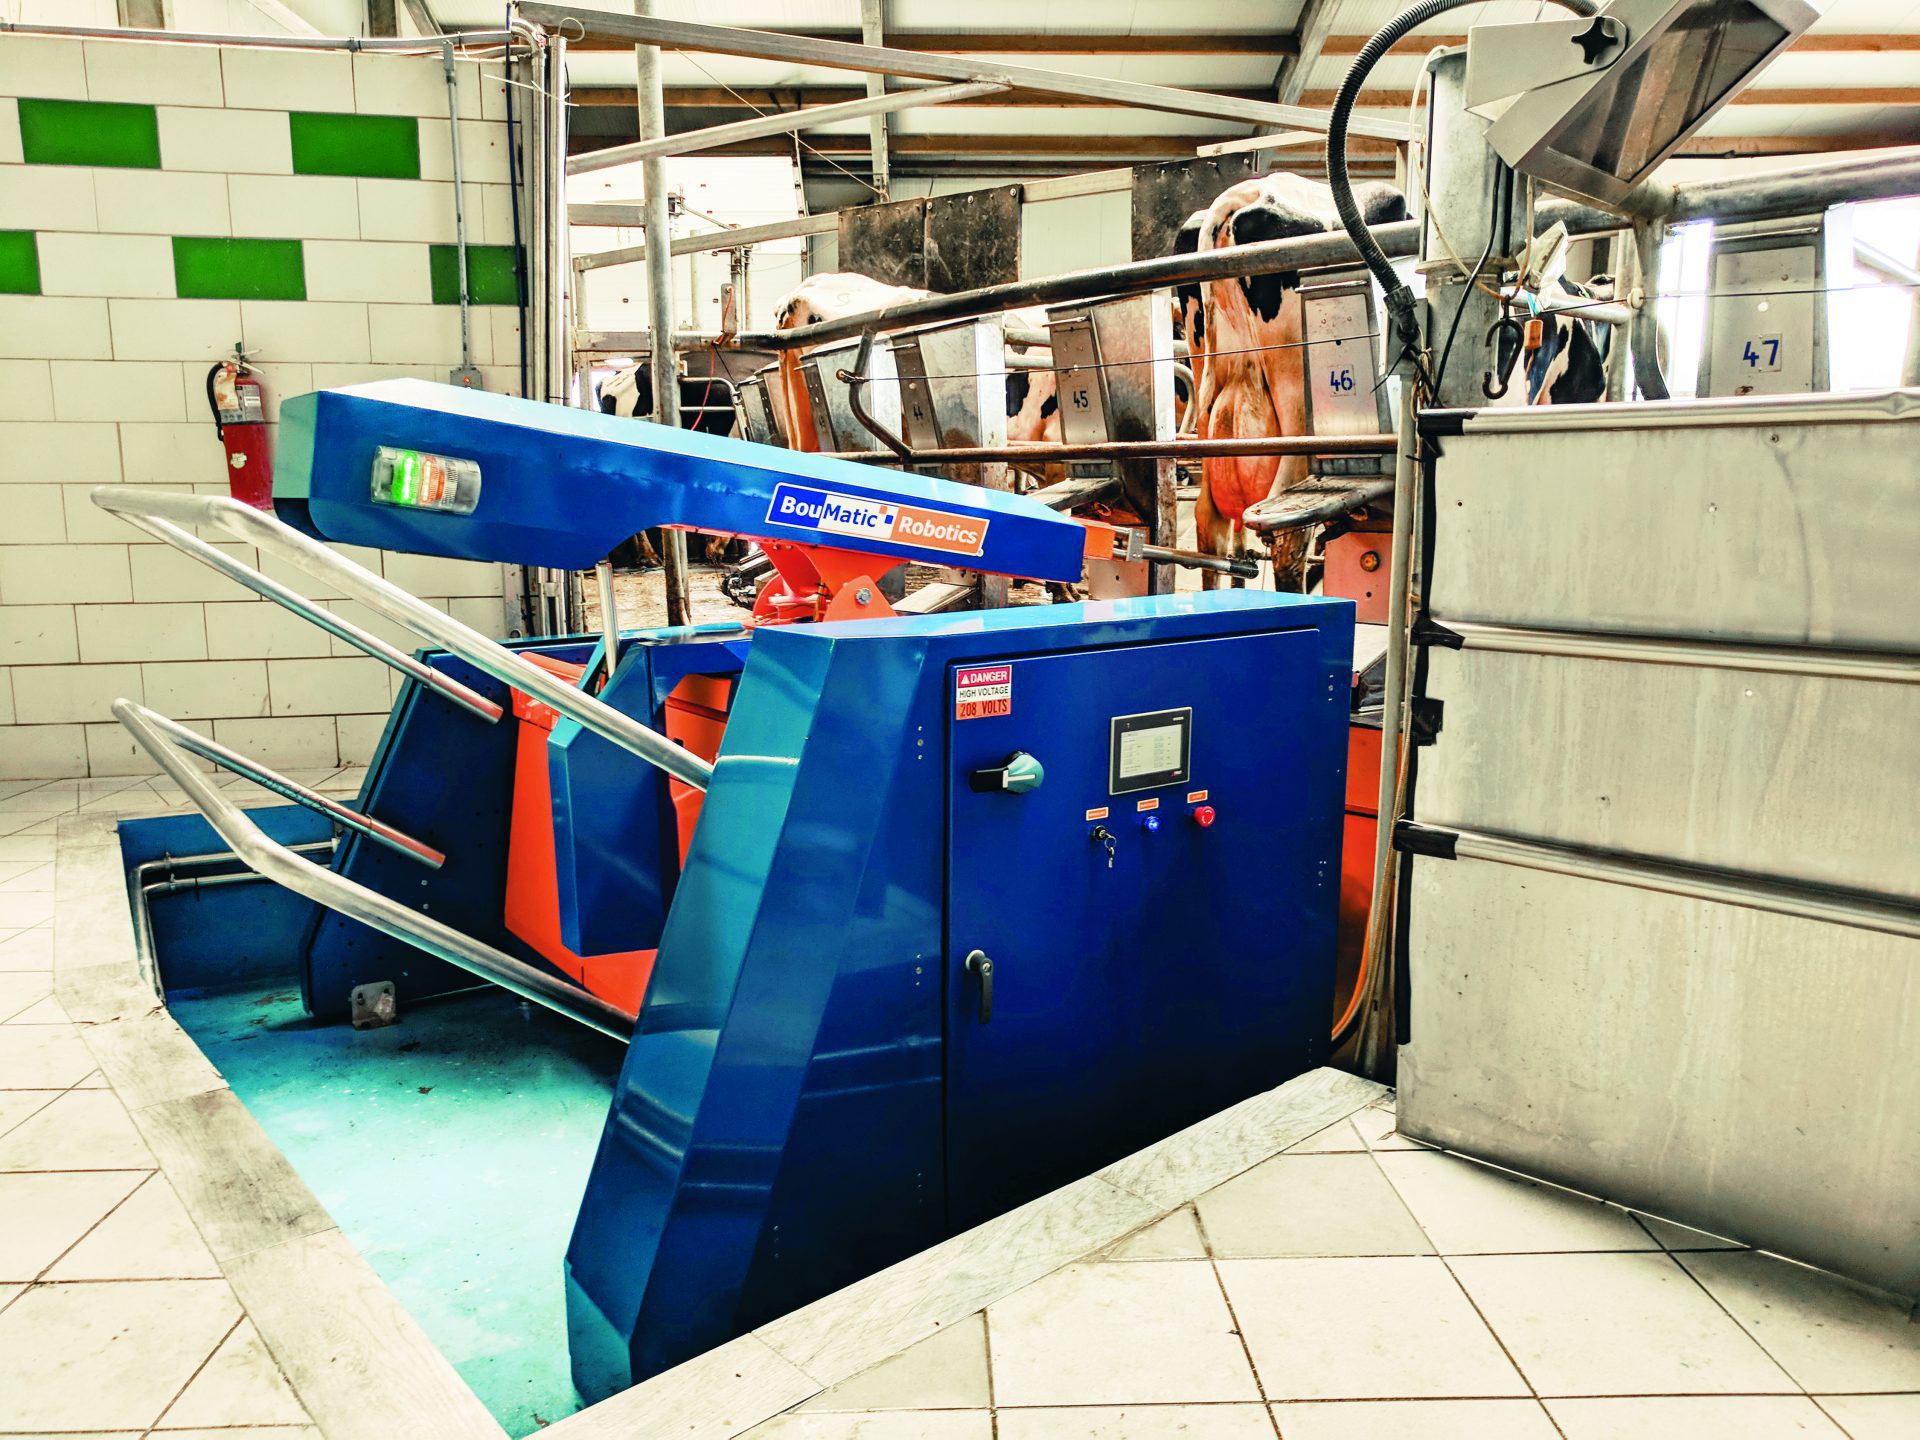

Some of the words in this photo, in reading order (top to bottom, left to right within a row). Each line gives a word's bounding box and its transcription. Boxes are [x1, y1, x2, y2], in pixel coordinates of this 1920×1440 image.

[1742, 339, 1779, 367] 47
[1330, 369, 1353, 391] 46
[1073, 390, 1088, 408] 45
[780, 495, 878, 528] BouMatic
[898, 517, 977, 545] Robotics
[970, 670, 1007, 684] DANGER
[959, 689, 976, 698] HIGH
[978, 685, 1008, 696] VOLTAGE
[960, 702, 977, 717] 208
[982, 699, 1007, 714] VOLTS
